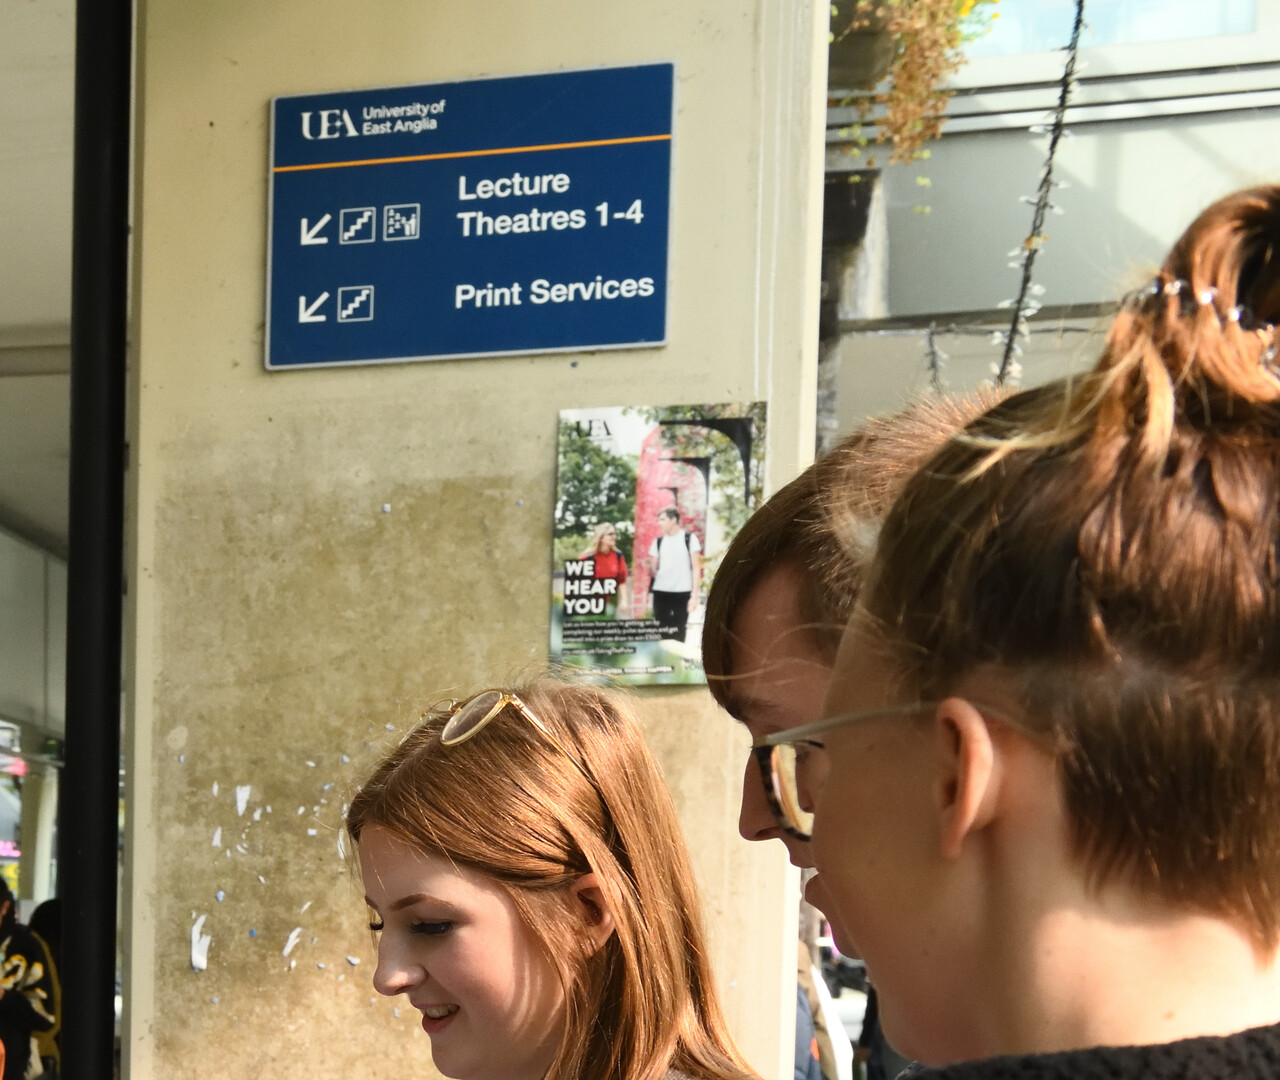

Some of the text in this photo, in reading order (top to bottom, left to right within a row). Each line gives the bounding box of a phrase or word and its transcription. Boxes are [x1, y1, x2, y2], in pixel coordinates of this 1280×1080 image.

[362, 99, 446, 120] University of
[301, 109, 360, 140] UEA
[362, 118, 437, 136] East Anglia
[458, 172, 570, 201] Lecture
[458, 199, 644, 238] Theatres 1-4
[456, 276, 654, 309] Print Services
[565, 560, 594, 577] WE
[565, 579, 616, 595] HEAR
[564, 598, 604, 614] YOU
